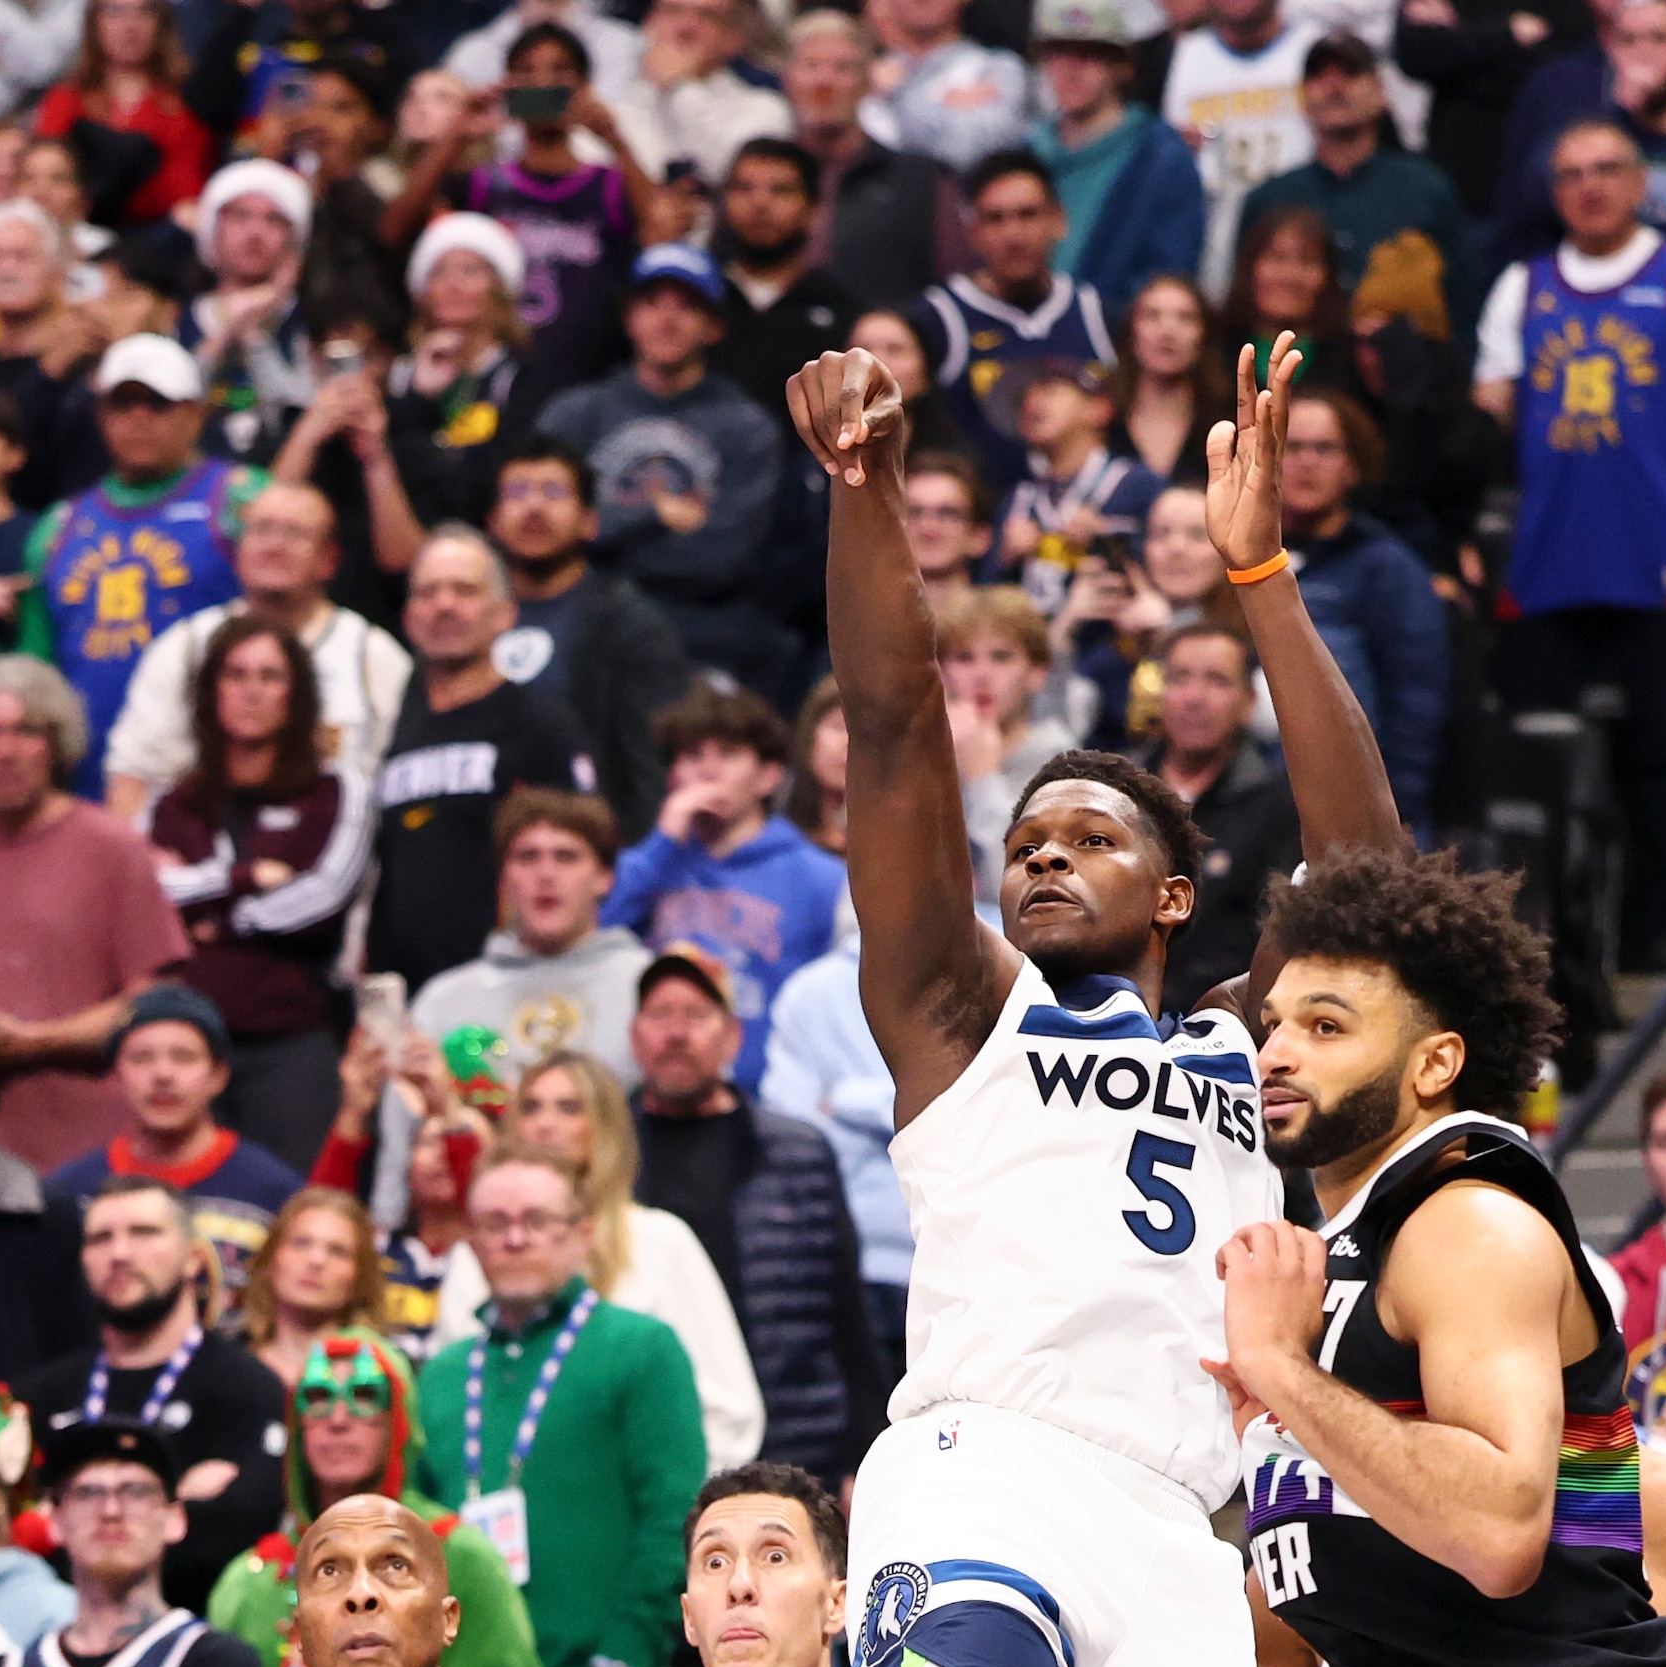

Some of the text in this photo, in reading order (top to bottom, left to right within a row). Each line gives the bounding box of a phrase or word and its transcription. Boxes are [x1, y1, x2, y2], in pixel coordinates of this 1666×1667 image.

[1026, 1051, 1256, 1153] WOLVES
[1122, 1129, 1196, 1256] 5
[1318, 1280, 1367, 1373] 7
